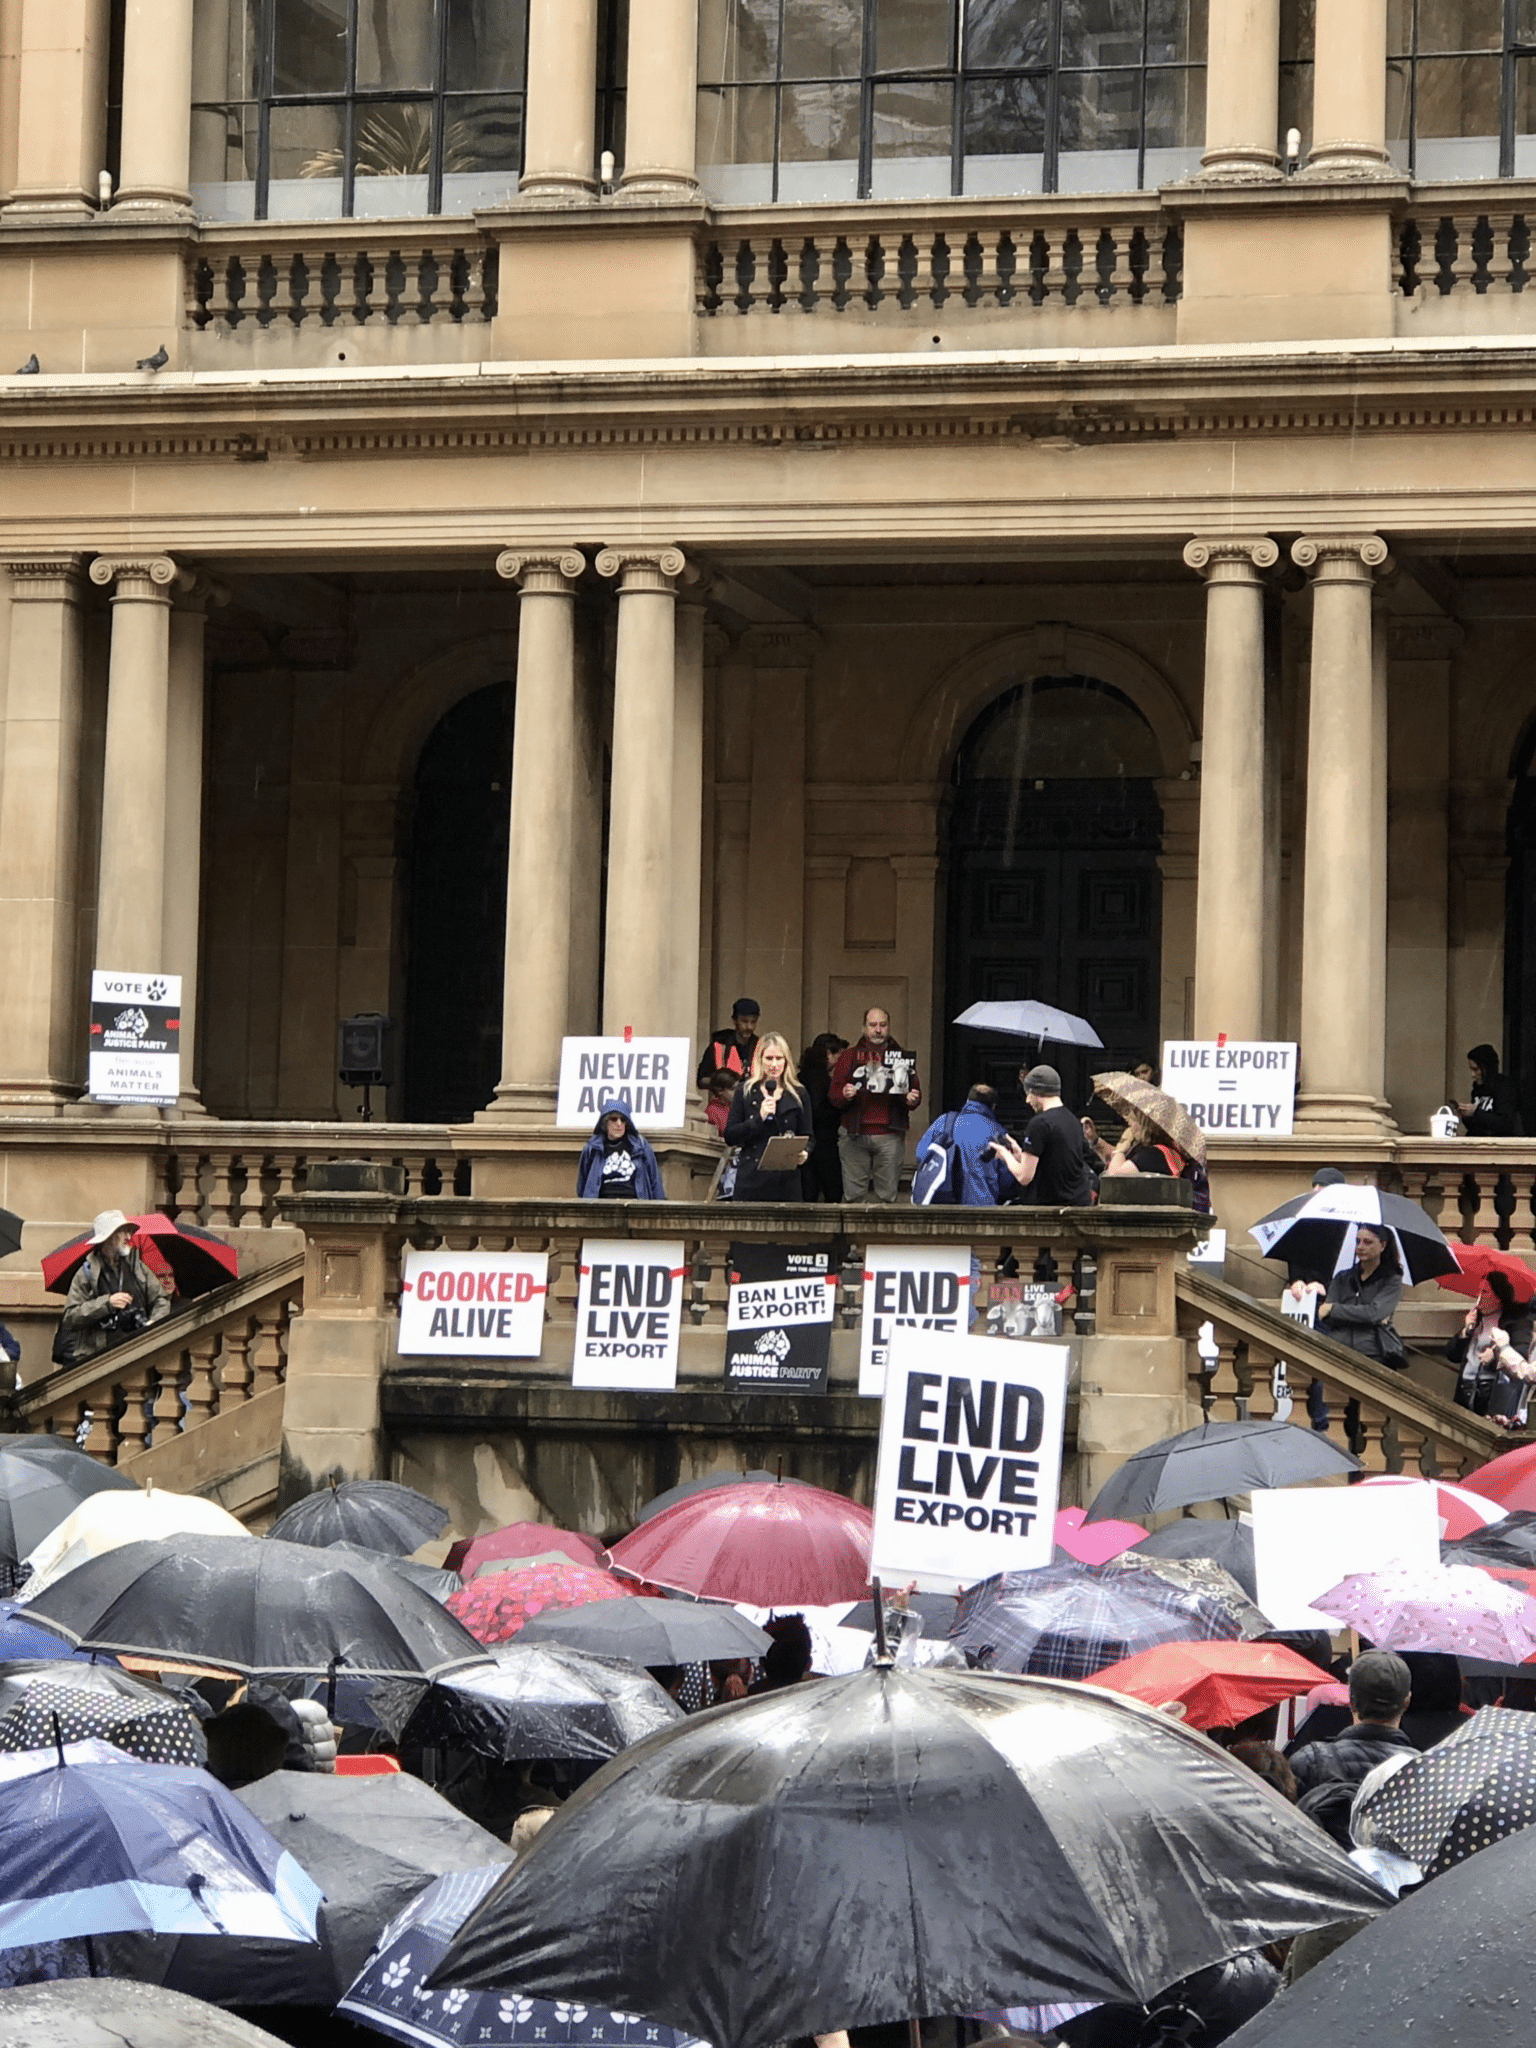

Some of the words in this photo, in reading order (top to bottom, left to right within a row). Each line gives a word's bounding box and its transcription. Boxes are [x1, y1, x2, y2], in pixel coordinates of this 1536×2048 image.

[104, 982, 143, 994] VOTE
[103, 1030, 138, 1040] ANIMAL
[103, 1039, 138, 1049] JUSTICE
[138, 1040, 168, 1050] PARTY
[885, 1050, 902, 1058] LIVE
[1170, 1050, 1210, 1068] LIVE
[1215, 1050, 1290, 1069] EXPORT
[107, 1068, 163, 1079] ANIMALS
[579, 1053, 670, 1080] NEVER
[110, 1081, 160, 1091] MATTER
[1180, 1103, 1281, 1129] RUELTY
[787, 1254, 814, 1265] VOTE
[417, 1271, 534, 1302] COOKED
[589, 1264, 673, 1308] END
[738, 1287, 776, 1304] BAN
[783, 1284, 825, 1300] LIVE
[874, 1271, 959, 1315] END
[1024, 1284, 1045, 1293] LIVE
[738, 1300, 826, 1320] EXPORT!
[429, 1308, 513, 1338] ALIVE
[587, 1311, 670, 1339] LIVE
[585, 1342, 668, 1358] EXPORT
[731, 1353, 779, 1366] ANIMAL
[729, 1365, 779, 1378] JUSTICE
[779, 1367, 822, 1379] PARTY
[903, 1371, 1044, 1453] END
[898, 1445, 1039, 1507] LIVE
[895, 1497, 1036, 1537] EXPORT
